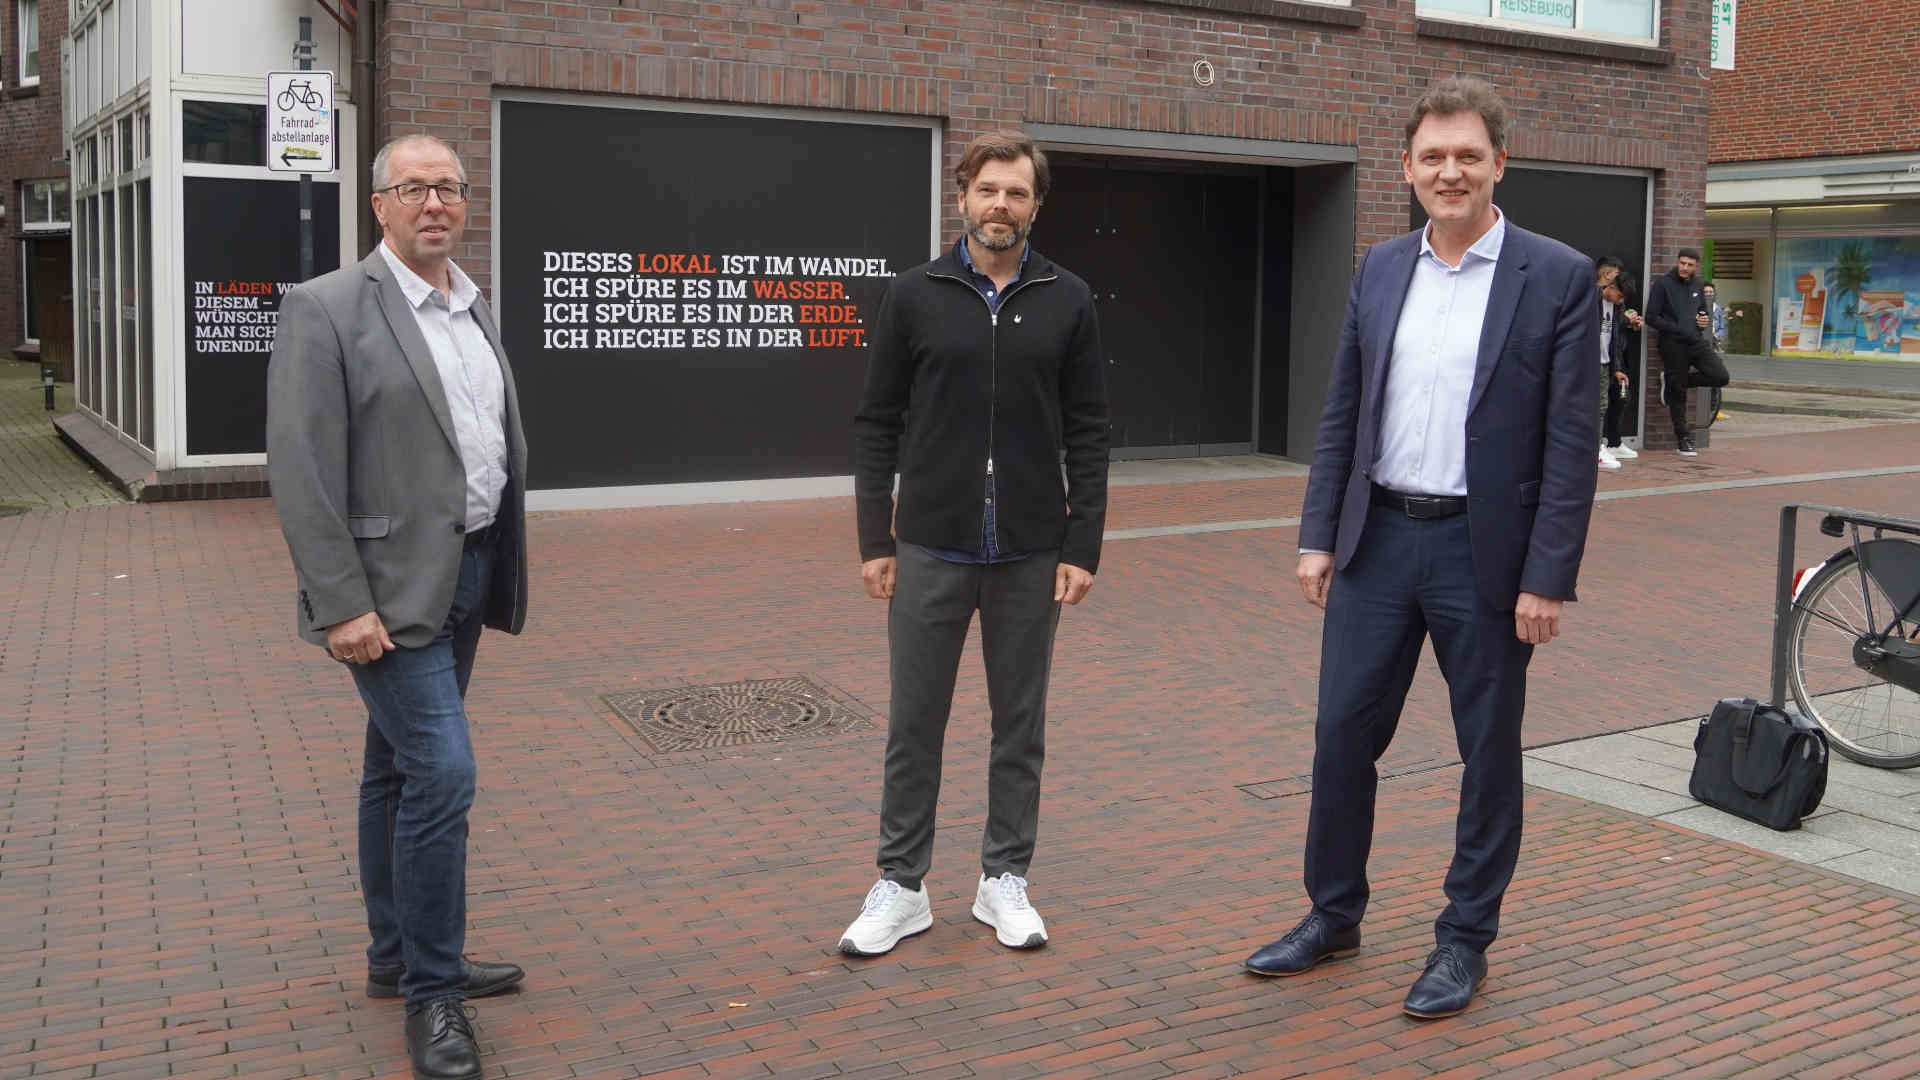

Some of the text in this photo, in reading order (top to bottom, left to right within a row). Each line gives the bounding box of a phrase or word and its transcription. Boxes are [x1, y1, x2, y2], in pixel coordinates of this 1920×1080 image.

[281, 116, 319, 128] Fahrrad-
[272, 131, 330, 146] abstellanlage
[544, 251, 896, 278] DIESES LOKAL IST IM WANDEL.
[195, 281, 214, 294] IN
[218, 280, 273, 294] LÄDEN
[544, 274, 850, 300] ICH SPÜRE ES IM WASSER.
[195, 296, 259, 309] DIESEM
[195, 308, 279, 324] WÜNSCHT
[544, 299, 863, 324] ICH SPÜRE ES IN DER ERDE.
[195, 325, 277, 338] MAN SICH
[544, 328, 868, 349] ICH RIECHE ES IN DER LUFT.
